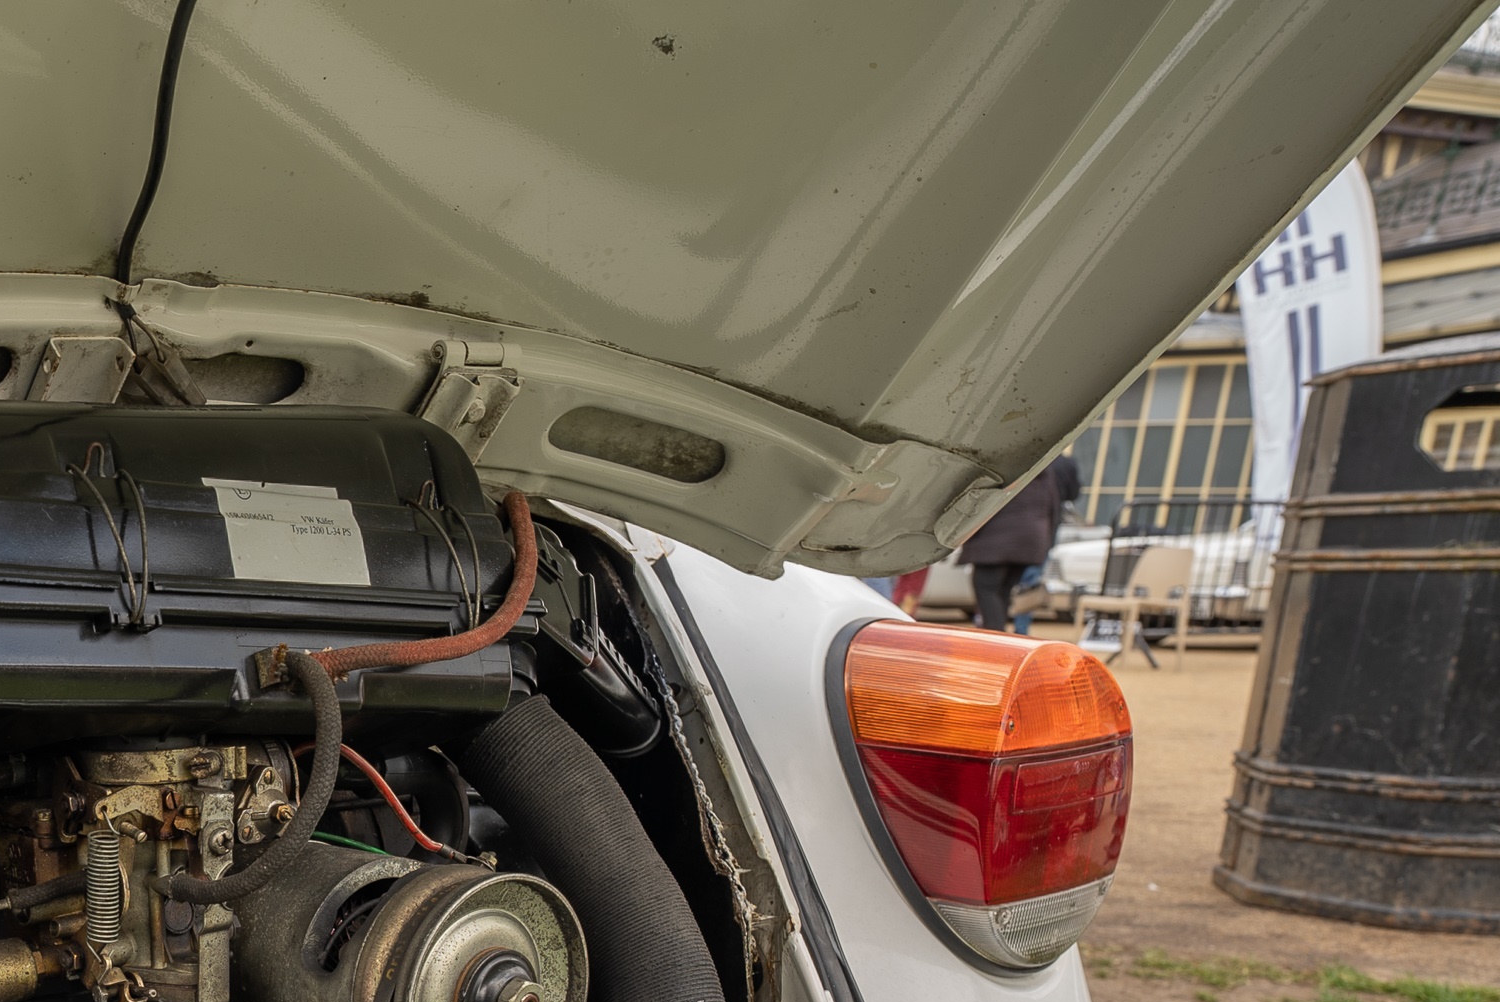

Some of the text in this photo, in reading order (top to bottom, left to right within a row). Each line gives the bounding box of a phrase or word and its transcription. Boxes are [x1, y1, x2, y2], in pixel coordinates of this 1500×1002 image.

[300, 515, 314, 523] VW
[290, 524, 309, 535] Type
[309, 525, 325, 535] 1200
[342, 527, 352, 537] PS
